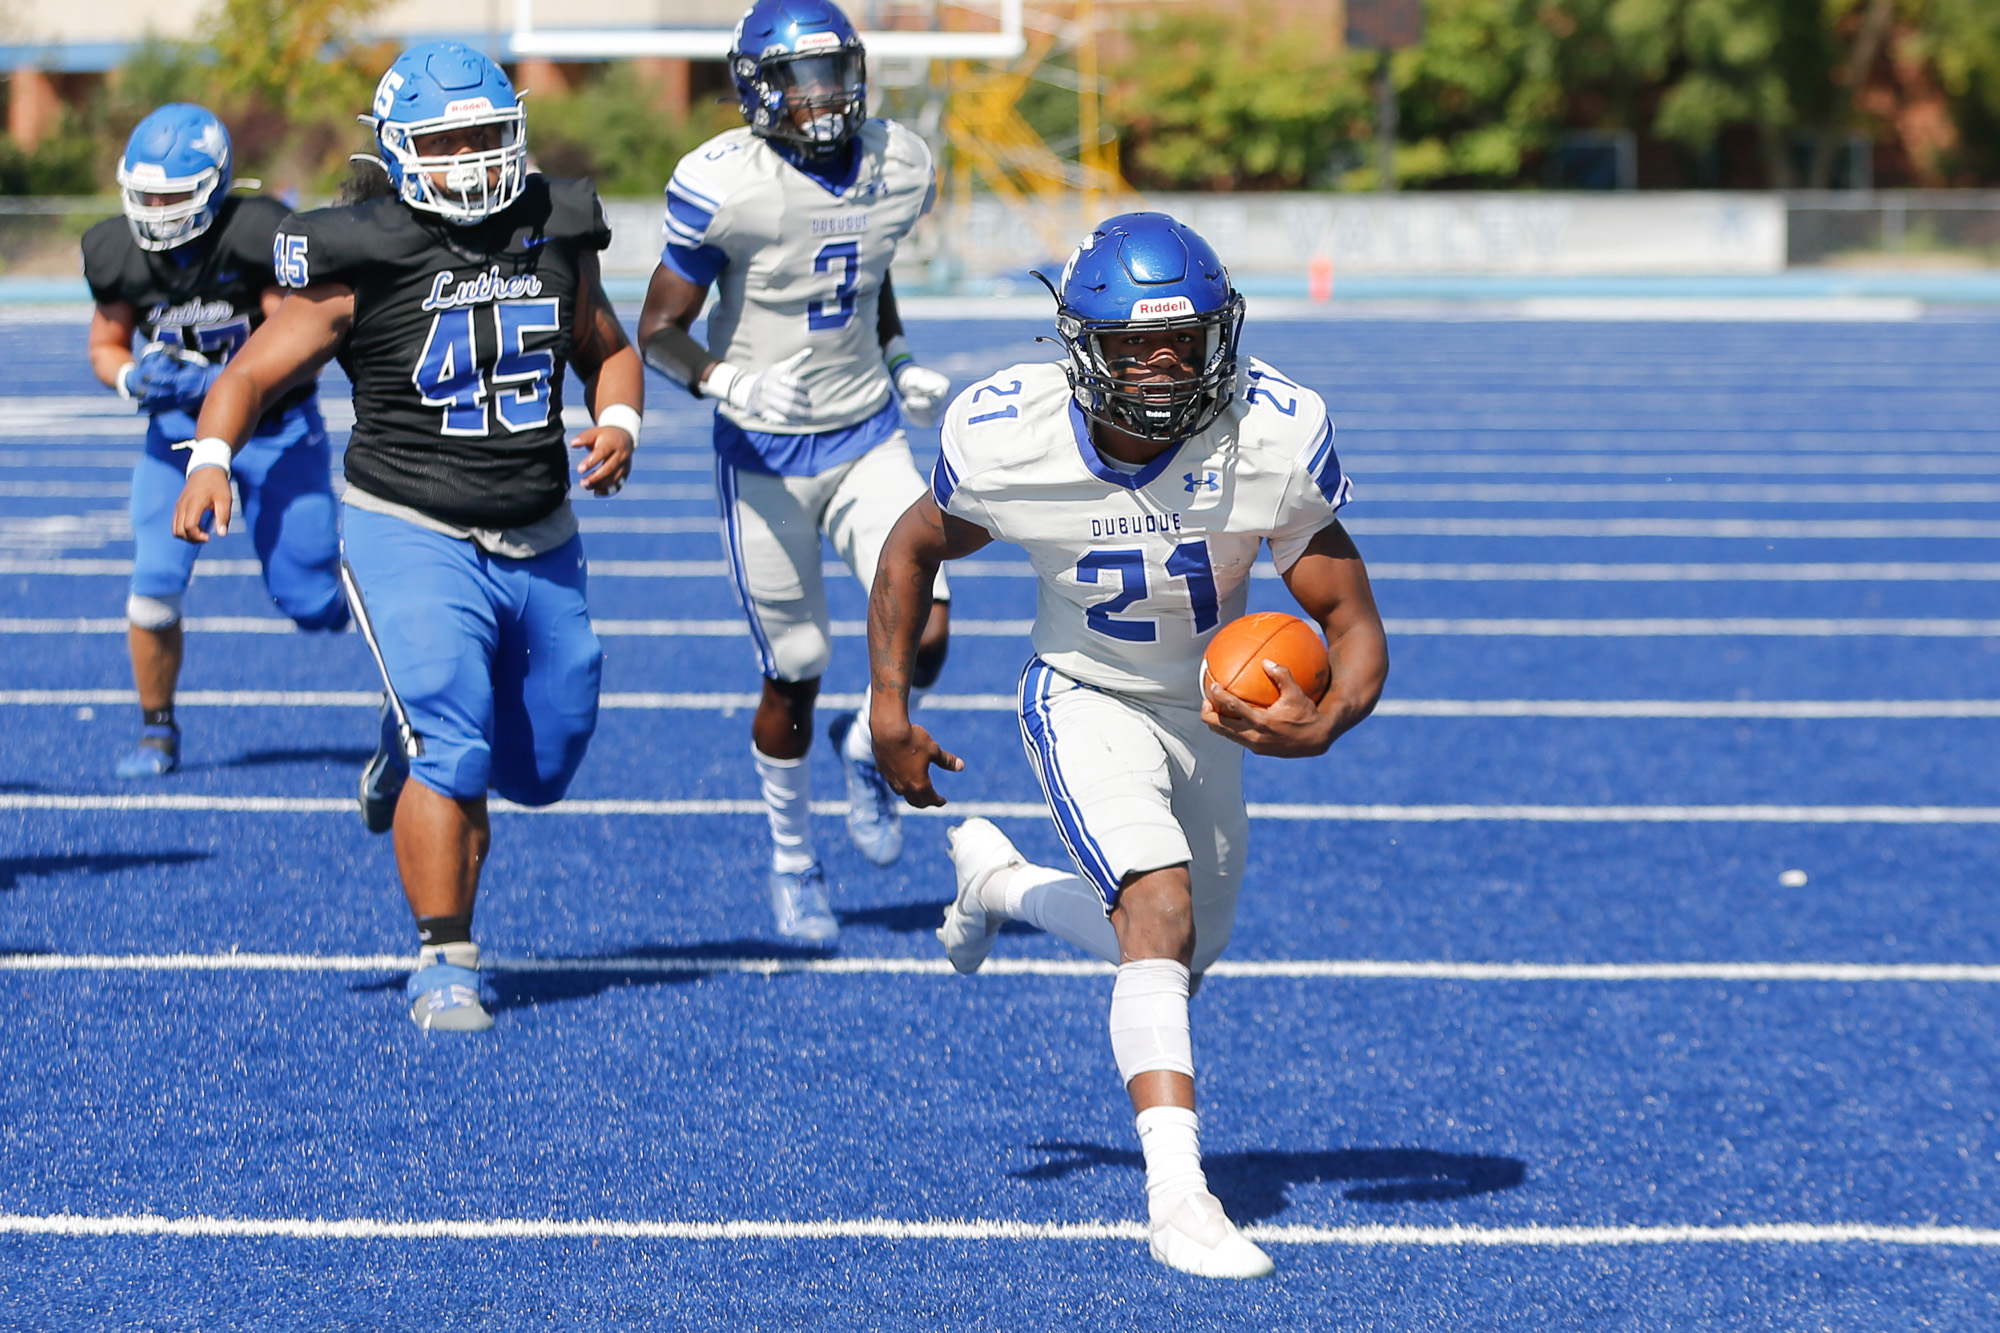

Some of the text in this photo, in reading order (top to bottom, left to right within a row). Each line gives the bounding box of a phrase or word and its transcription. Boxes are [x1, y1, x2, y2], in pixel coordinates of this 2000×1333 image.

[273, 232, 309, 288] 45
[422, 265, 543, 311] Luther
[808, 236, 861, 332] 3
[1140, 301, 1187, 314] Riddell
[147, 296, 234, 326] Luther
[412, 297, 560, 436] 45
[967, 380, 1022, 425] 21
[1246, 369, 1298, 417] 21
[1090, 512, 1182, 537] DUBUQUE
[1075, 538, 1219, 643] 21
